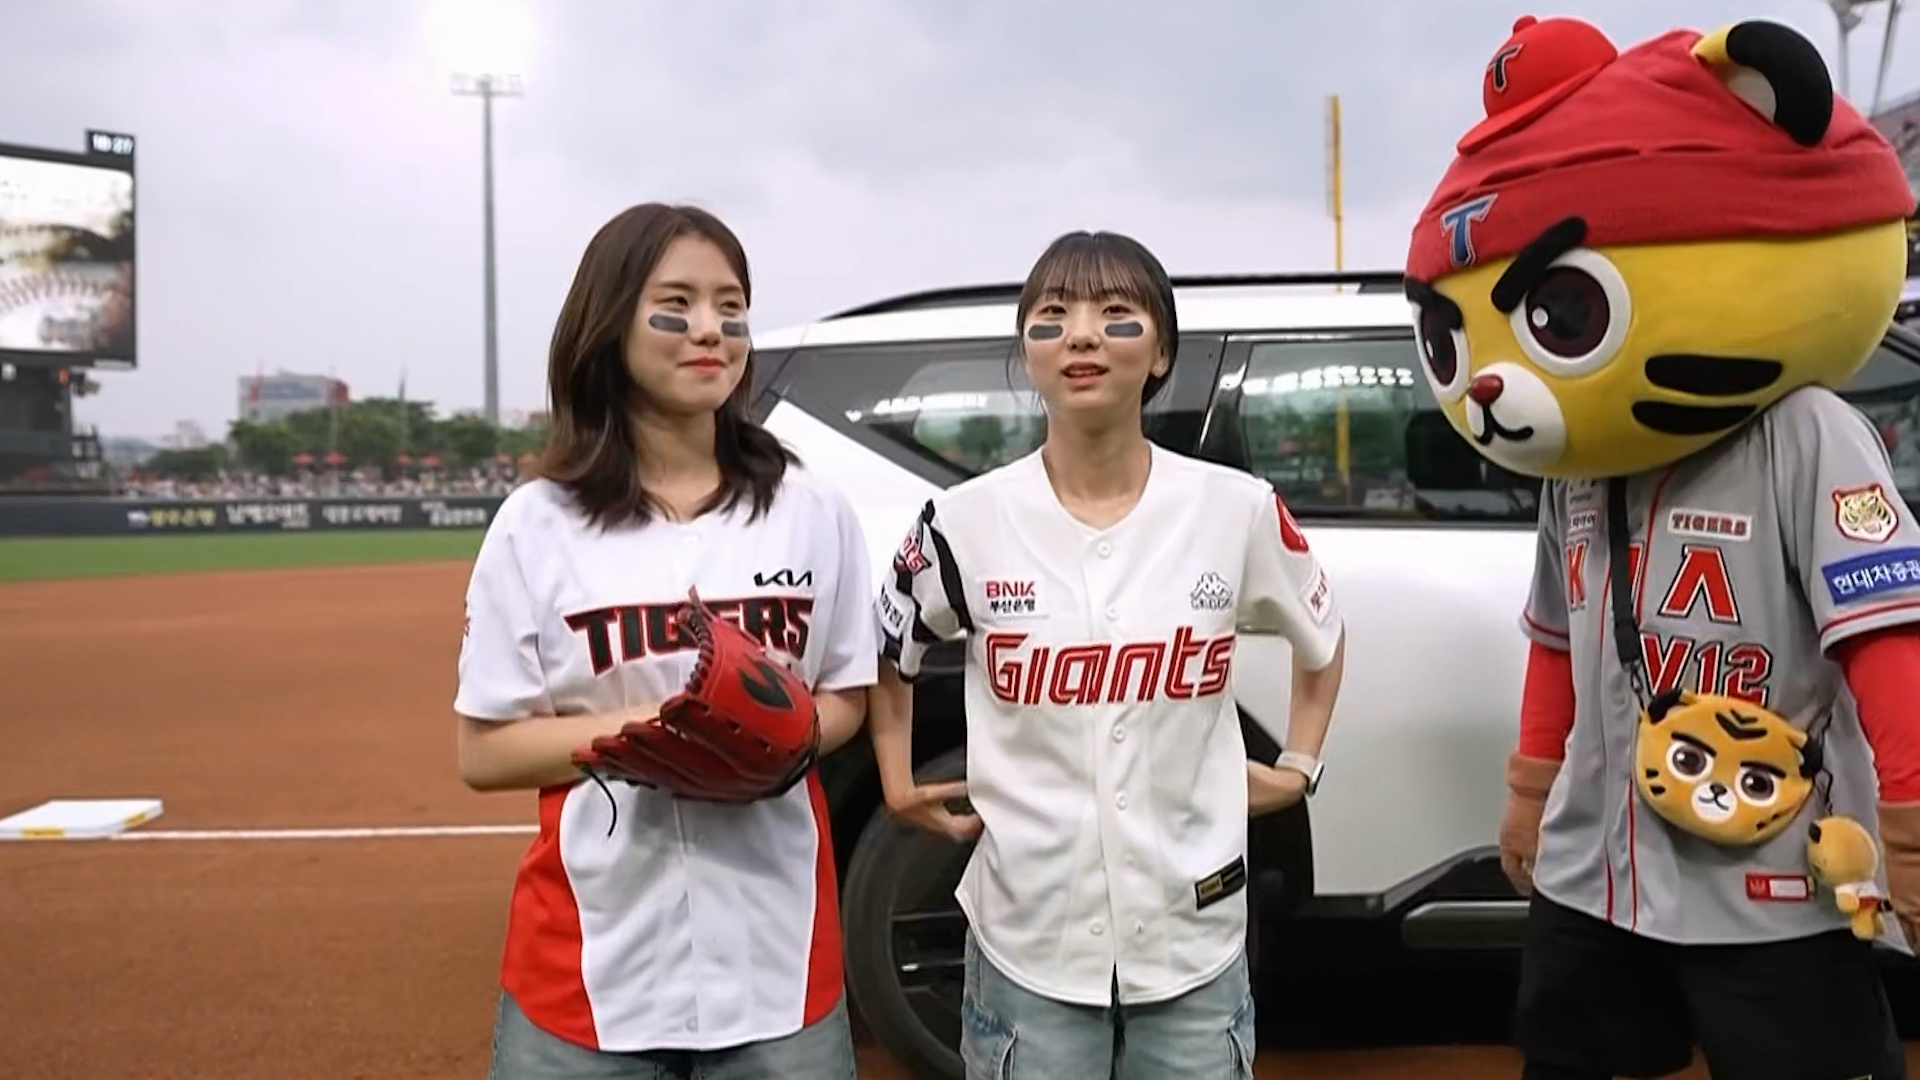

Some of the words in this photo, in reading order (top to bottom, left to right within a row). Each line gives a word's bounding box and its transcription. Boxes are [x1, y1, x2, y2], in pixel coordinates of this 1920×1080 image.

[1487, 44, 1522, 92] T
[1440, 193, 1499, 266] T
[1672, 512, 1748, 537] TIGERS
[753, 568, 813, 588] KIA
[985, 580, 1036, 599] BNK
[984, 625, 1237, 706] Giants
